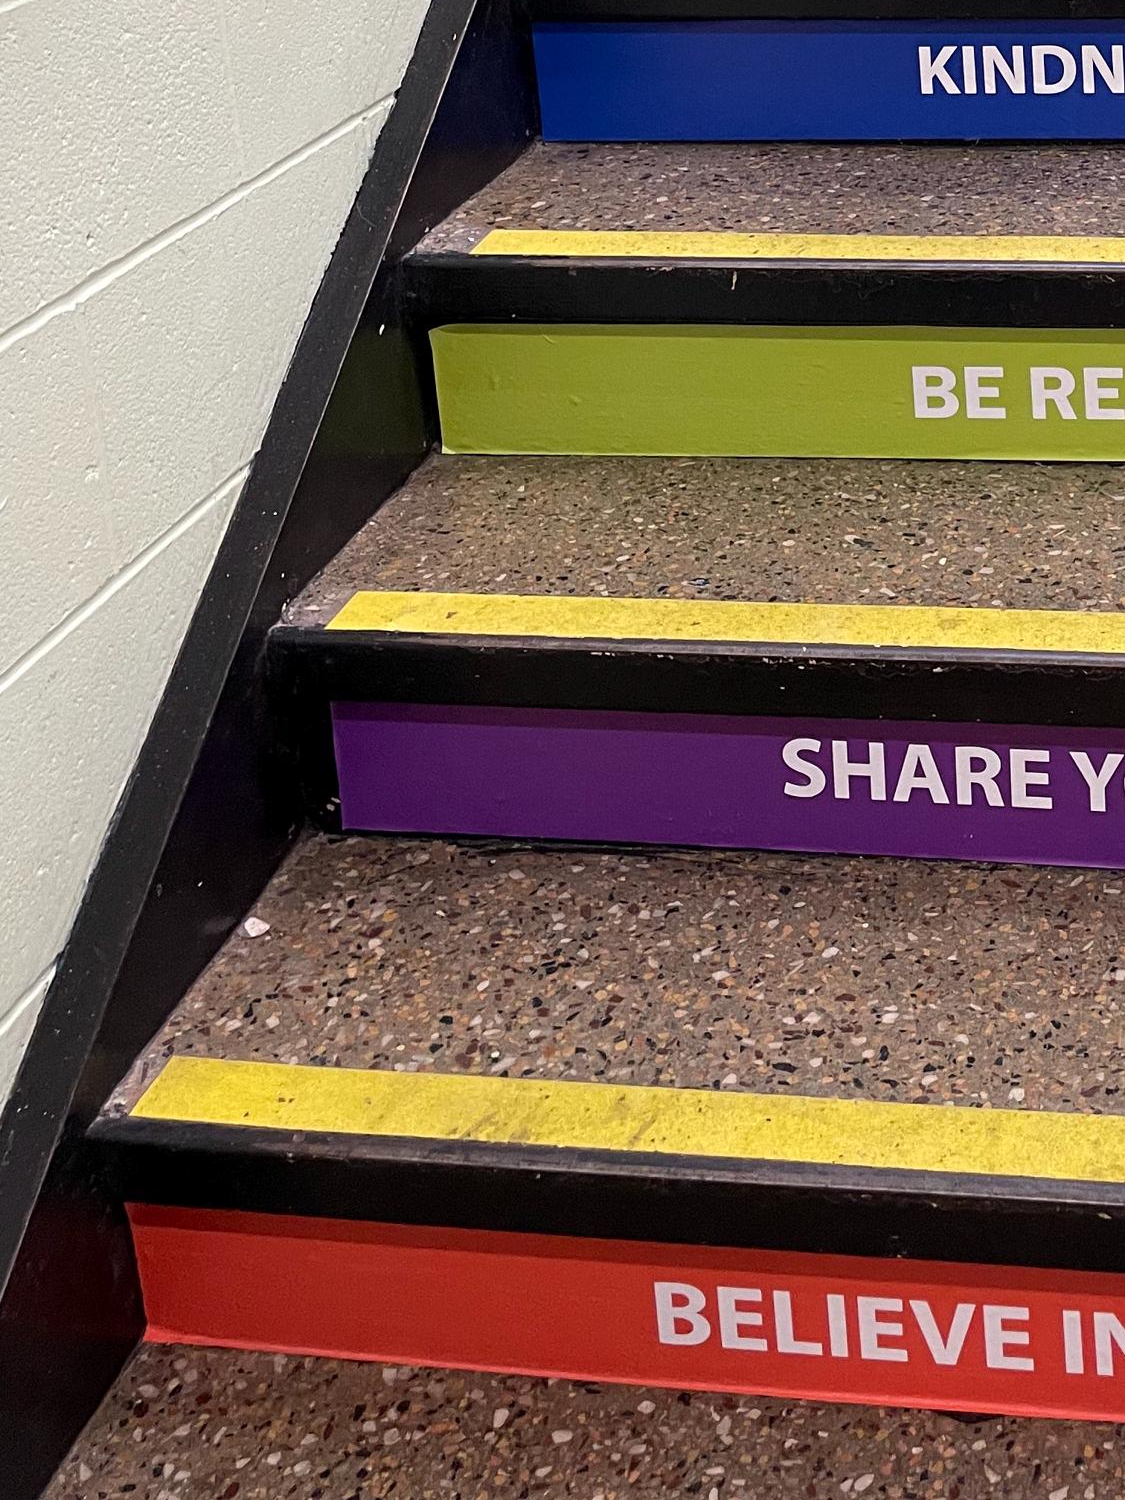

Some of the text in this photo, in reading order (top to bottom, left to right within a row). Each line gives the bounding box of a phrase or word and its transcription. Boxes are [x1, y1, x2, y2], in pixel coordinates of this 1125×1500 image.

[912, 366, 1006, 419] BE
[783, 738, 1052, 809] SHARE
[655, 1282, 1034, 1370] BELIEVE
